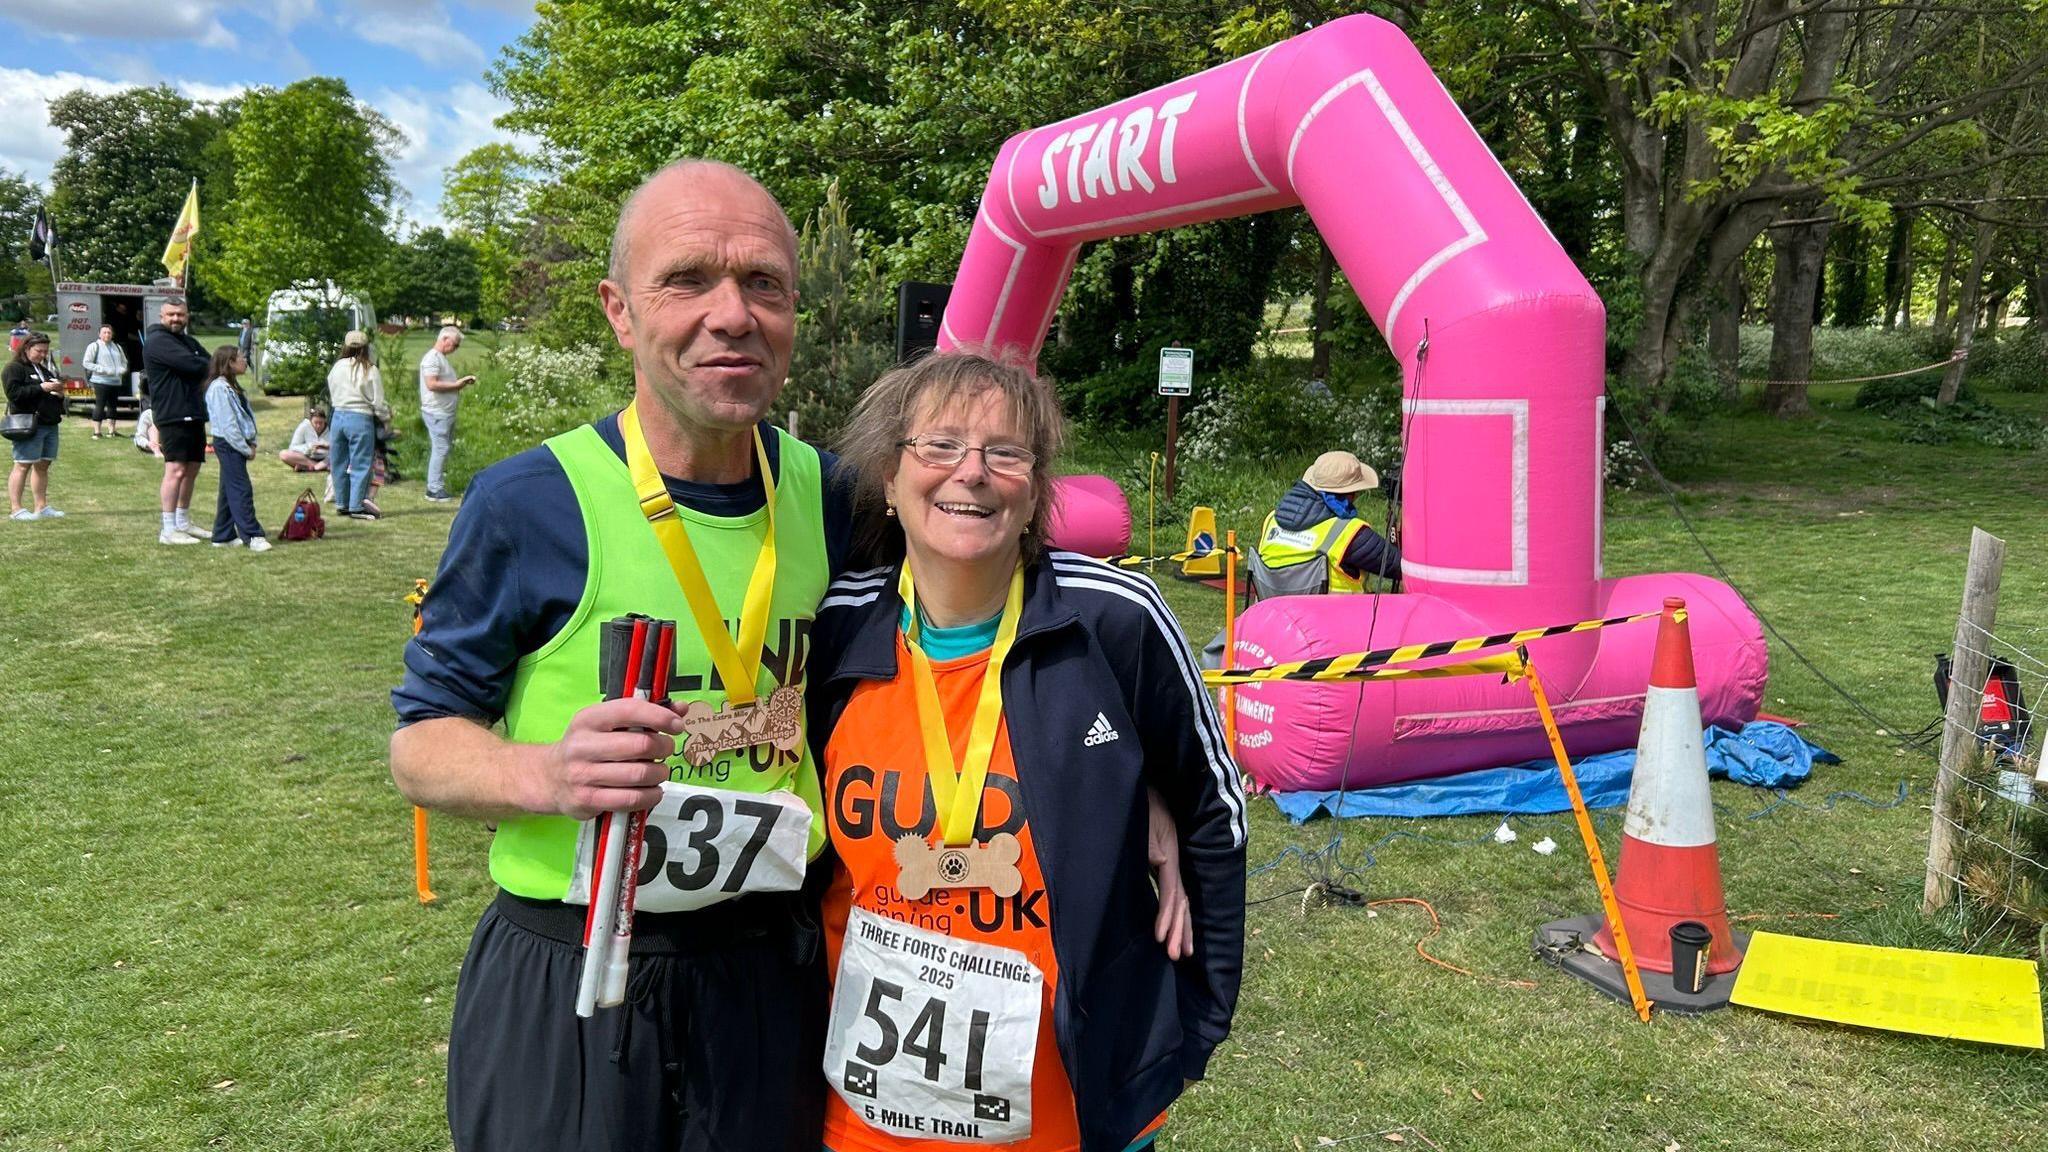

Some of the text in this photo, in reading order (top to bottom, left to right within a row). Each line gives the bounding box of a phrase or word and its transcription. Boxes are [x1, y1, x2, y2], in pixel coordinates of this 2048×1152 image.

[1037, 90, 1198, 210] START
[58, 283, 83, 292] LATTE
[95, 285, 143, 294] CAPPUCCINO
[67, 323, 91, 331] FOOD
[734, 710, 748, 718] Mile
[690, 729, 795, 752] Three Forts Challenge
[1083, 730, 1119, 747] adidas
[860, 920, 1031, 983] THREE FORTS CHALLENGE
[918, 964, 955, 990] 2025
[855, 976, 990, 1091] 541
[864, 1104, 983, 1139] 5 MILE TRAIL
